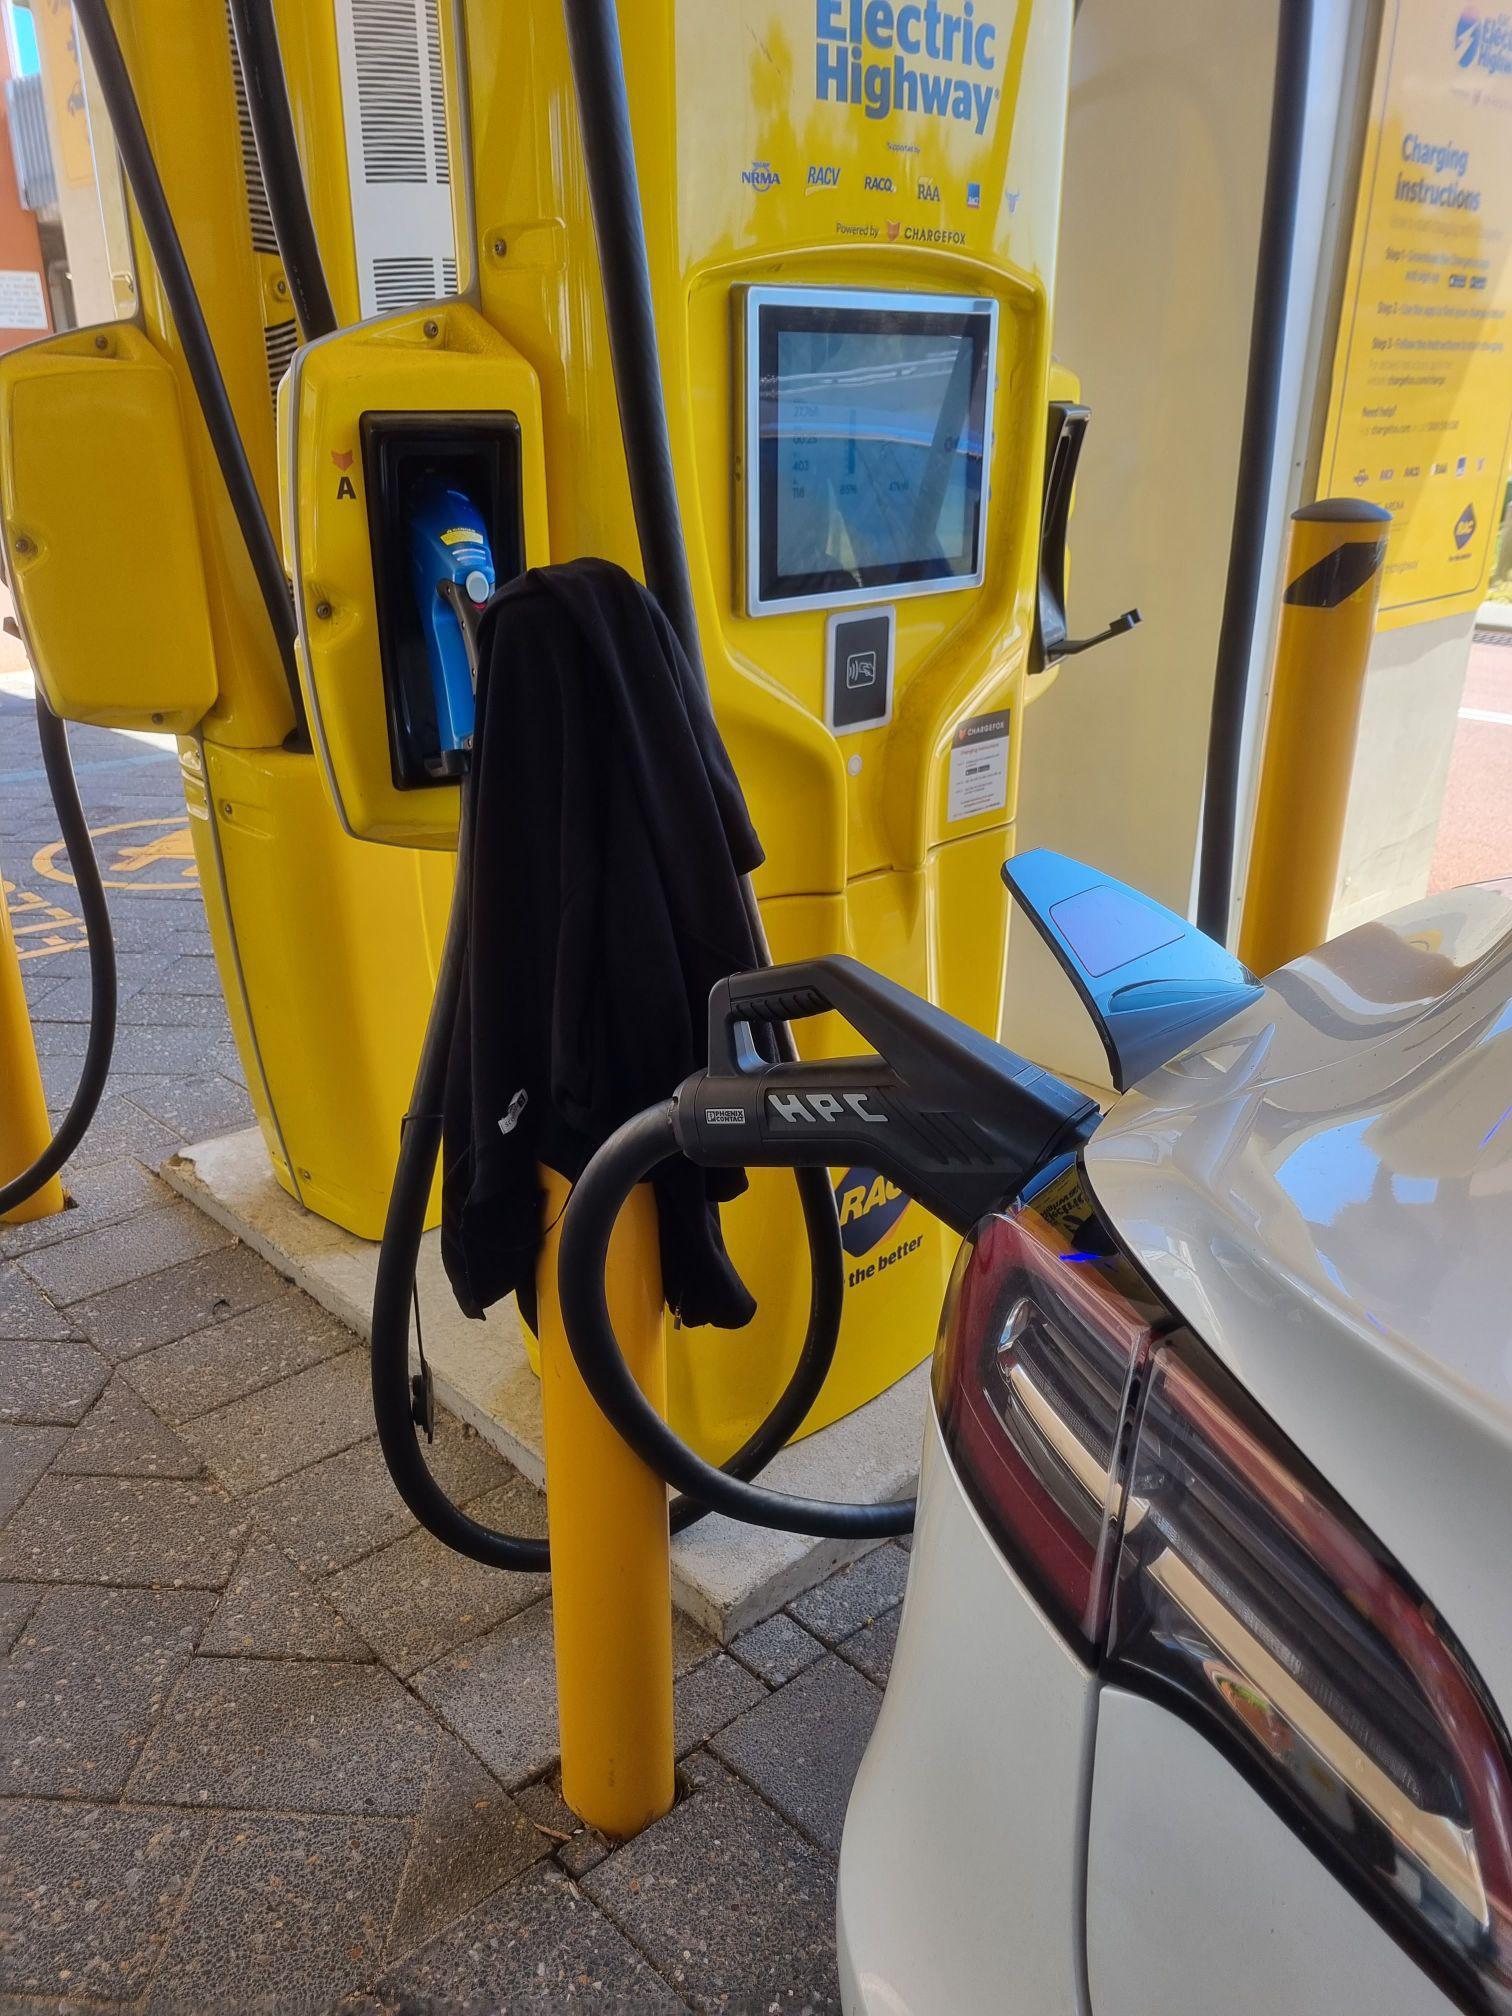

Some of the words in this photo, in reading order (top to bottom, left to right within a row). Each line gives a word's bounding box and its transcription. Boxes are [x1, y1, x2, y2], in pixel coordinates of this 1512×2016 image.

[815, 0, 996, 70] Electric
[815, 43, 994, 135] Highway
[1402, 133, 1470, 176] Charging
[741, 171, 781, 185] NRMA
[807, 165, 841, 186] RACV
[864, 176, 894, 193] RACQ
[917, 183, 941, 202] RAA
[1394, 172, 1482, 212] Instructions
[836, 222, 869, 236] Powered
[869, 225, 880, 239] by
[904, 227, 966, 245] CHARGEFOX
[336, 476, 356, 500] A
[967, 721, 1005, 736] CHARGEFOX
[768, 1093, 889, 1122] HPC
[849, 1264, 875, 1288] the
[878, 1235, 924, 1272] better
